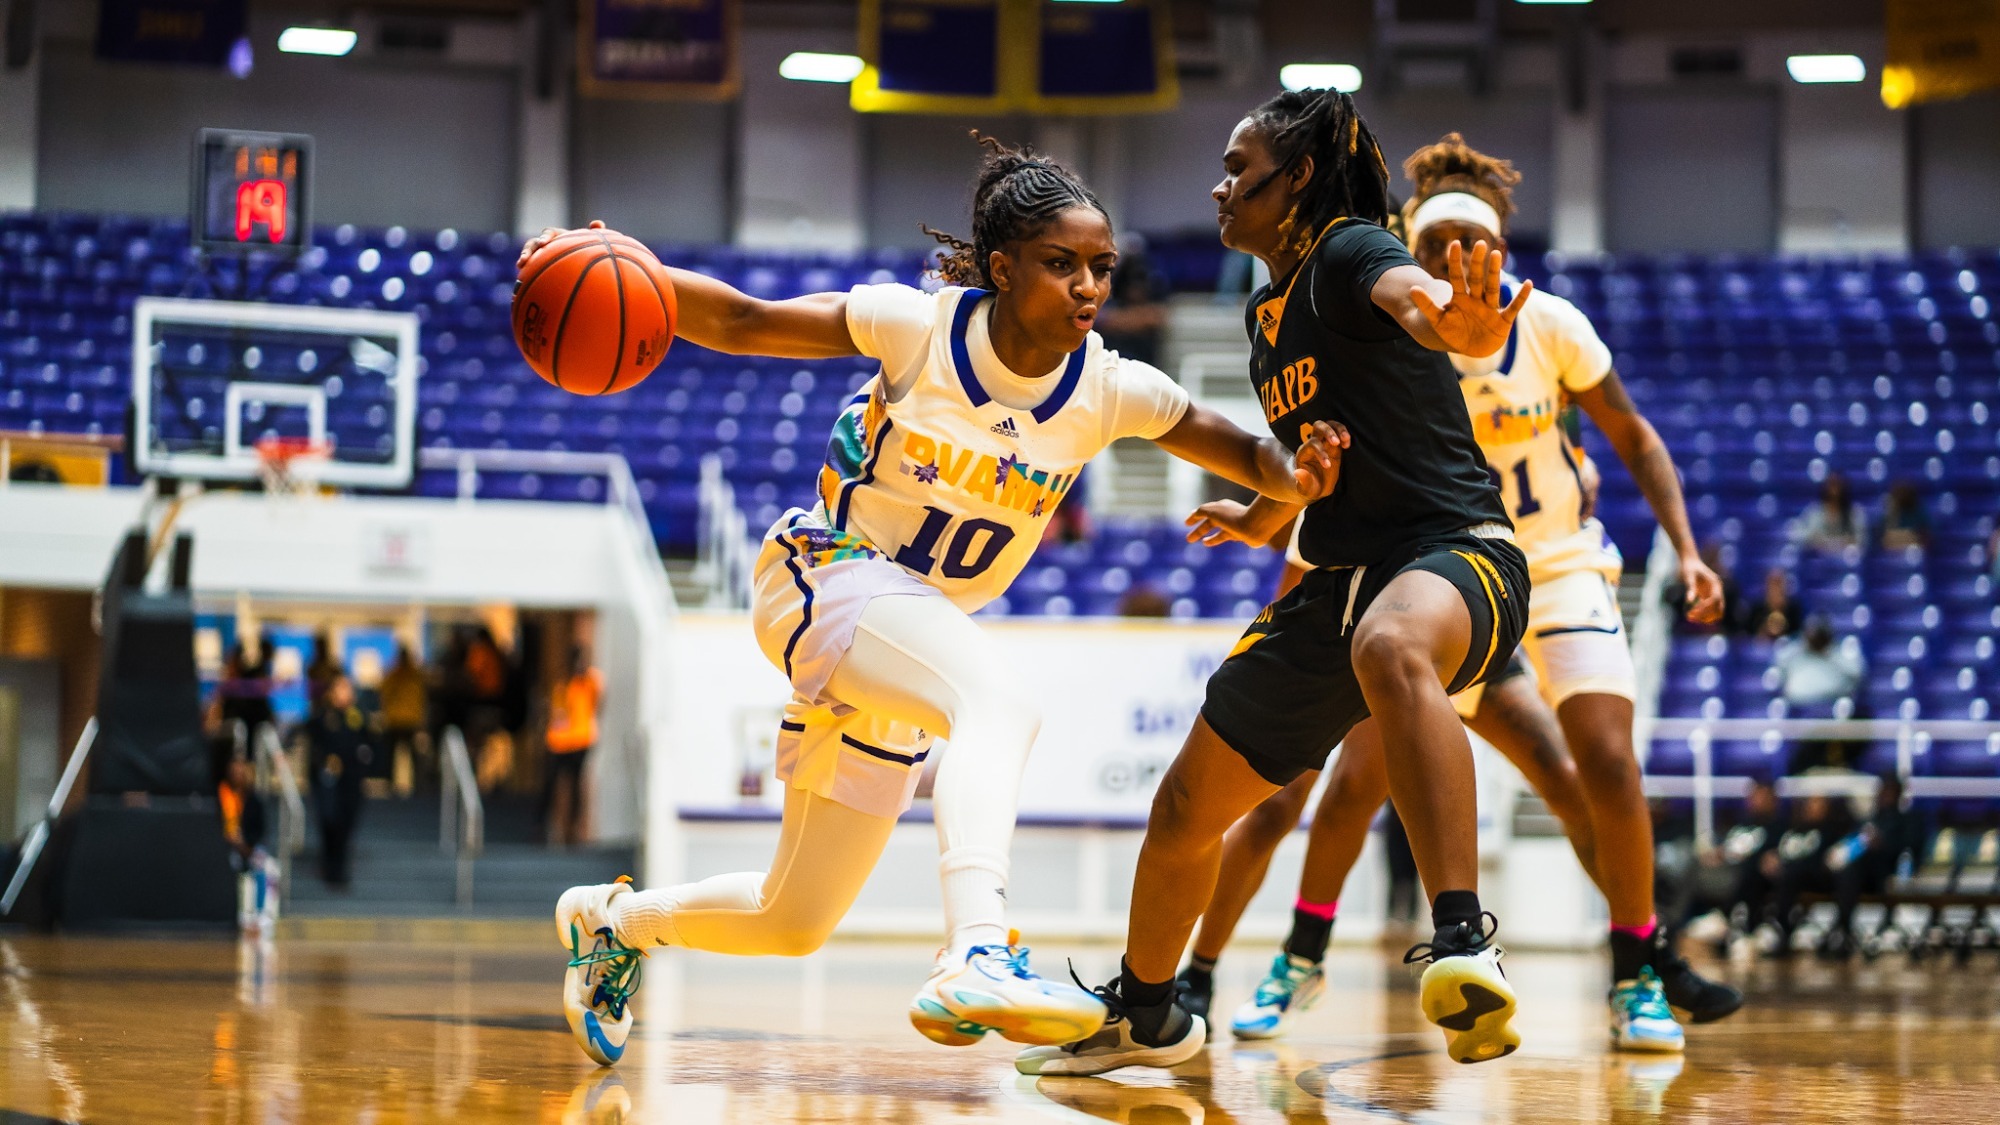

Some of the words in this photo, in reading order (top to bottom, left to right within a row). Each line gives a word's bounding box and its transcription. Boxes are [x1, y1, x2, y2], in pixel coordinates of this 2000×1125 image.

[236, 180, 286, 243] 19
[990, 426, 1020, 438] adidas
[894, 506, 1016, 579] 10
